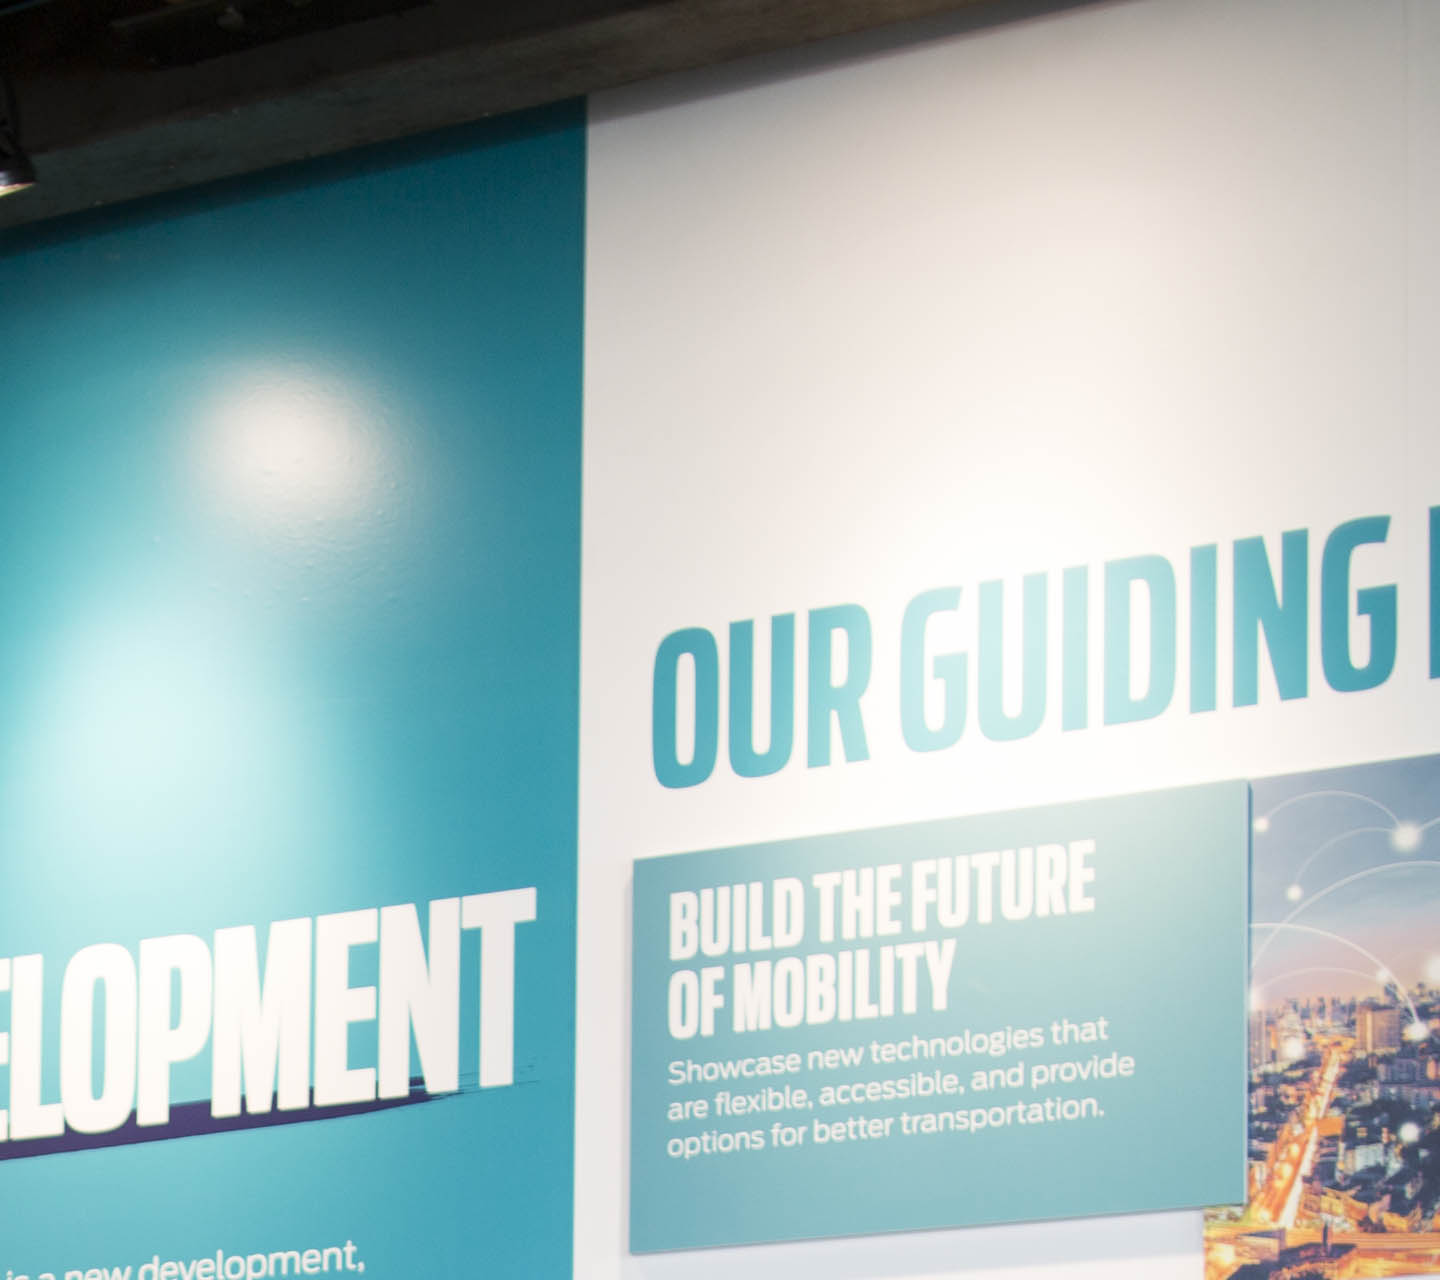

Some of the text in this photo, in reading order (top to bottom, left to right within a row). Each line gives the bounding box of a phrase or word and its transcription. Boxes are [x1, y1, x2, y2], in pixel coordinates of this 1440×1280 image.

[652, 603, 872, 790] OUR
[898, 514, 1400, 755] GUIDING
[669, 838, 1097, 961] BUILD THE FUTURE
[668, 937, 958, 1040] OF MOBILITY
[668, 1016, 1109, 1086] Showcase new technologies that
